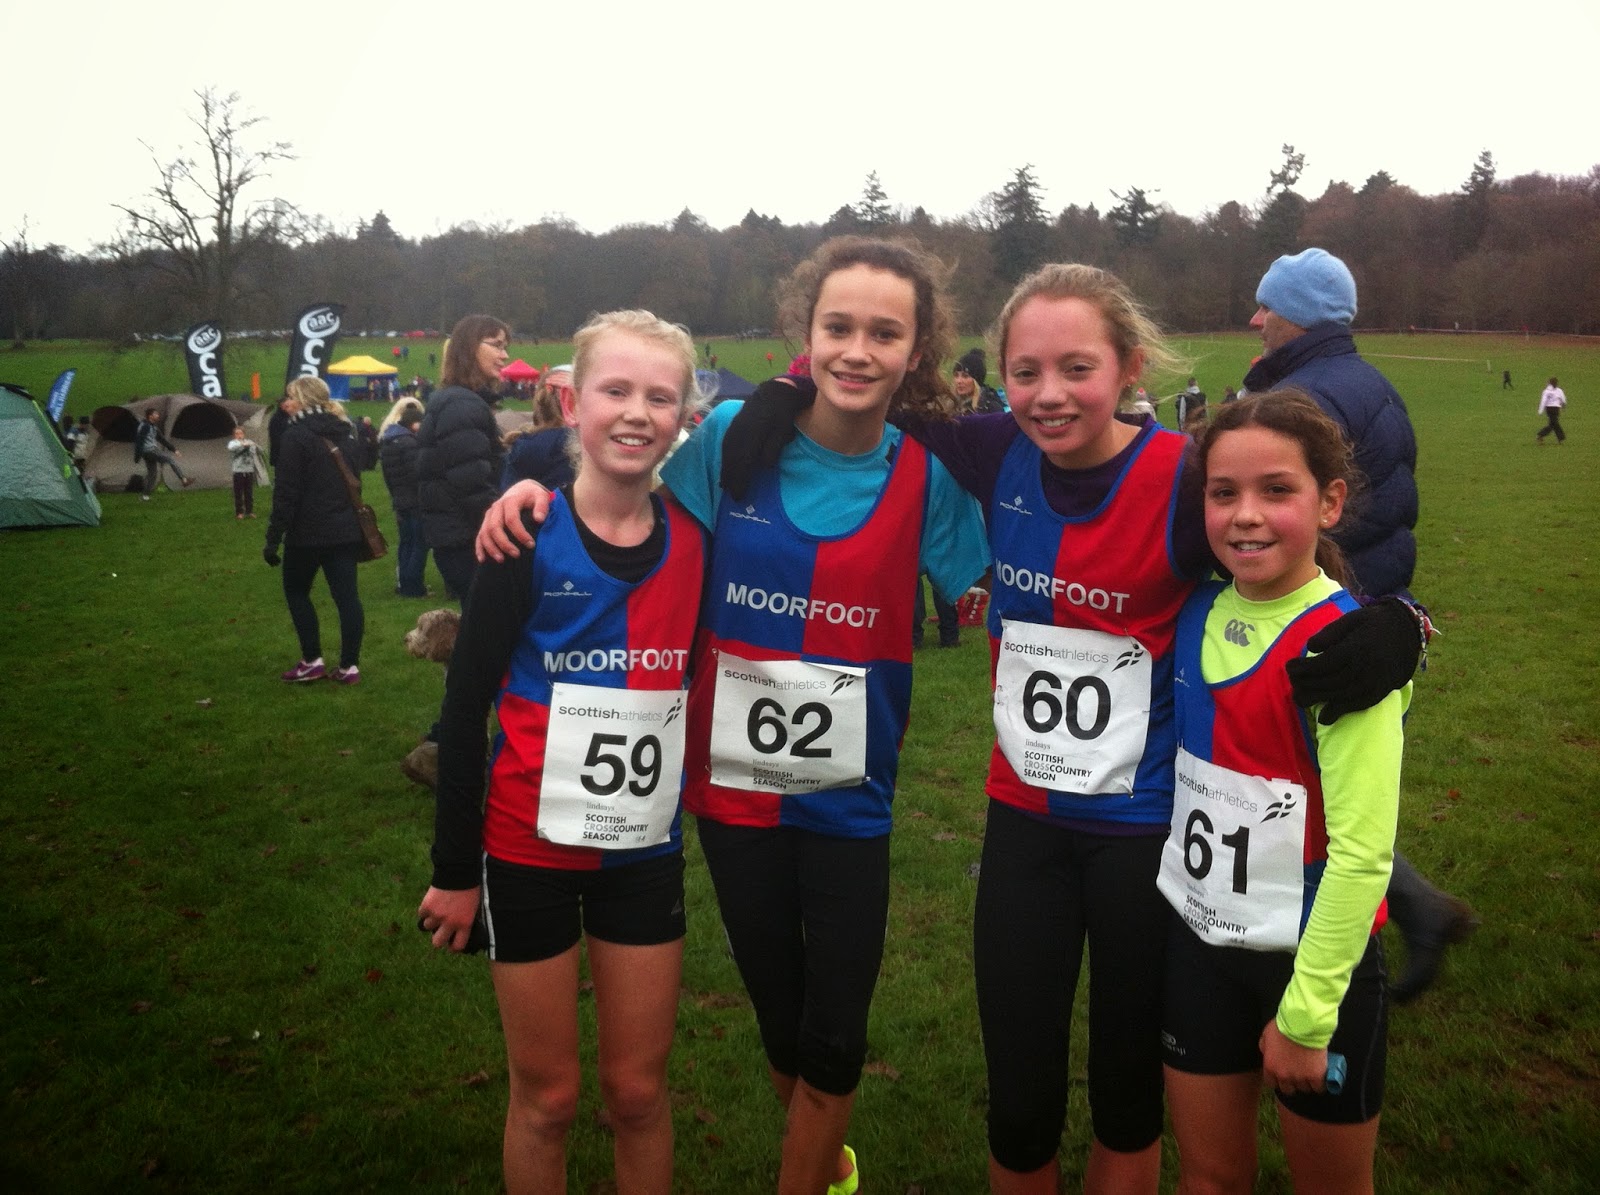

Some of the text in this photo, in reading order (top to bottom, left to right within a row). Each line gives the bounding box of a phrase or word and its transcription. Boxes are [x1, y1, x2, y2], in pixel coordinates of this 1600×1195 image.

[726, 582, 880, 629] MOORFOOT
[543, 648, 688, 673] MOORFOOT
[1004, 641, 1109, 664] scottishathletics
[724, 669, 827, 691] scottishathletics
[558, 705, 663, 721] scottishathletics
[1022, 670, 1111, 740] 60
[747, 697, 833, 758] 62
[580, 733, 662, 797] 59
[1024, 750, 1064, 764] SCOTTISH
[1023, 768, 1056, 781] SEASON
[1024, 760, 1092, 777] CROSSCOUNTRY
[753, 778, 787, 789] SEASON
[584, 822, 649, 832] CROSSCOUNTRY
[585, 813, 627, 823] SCOTTISH
[582, 831, 620, 841] SEASON
[1183, 809, 1250, 895] 61
